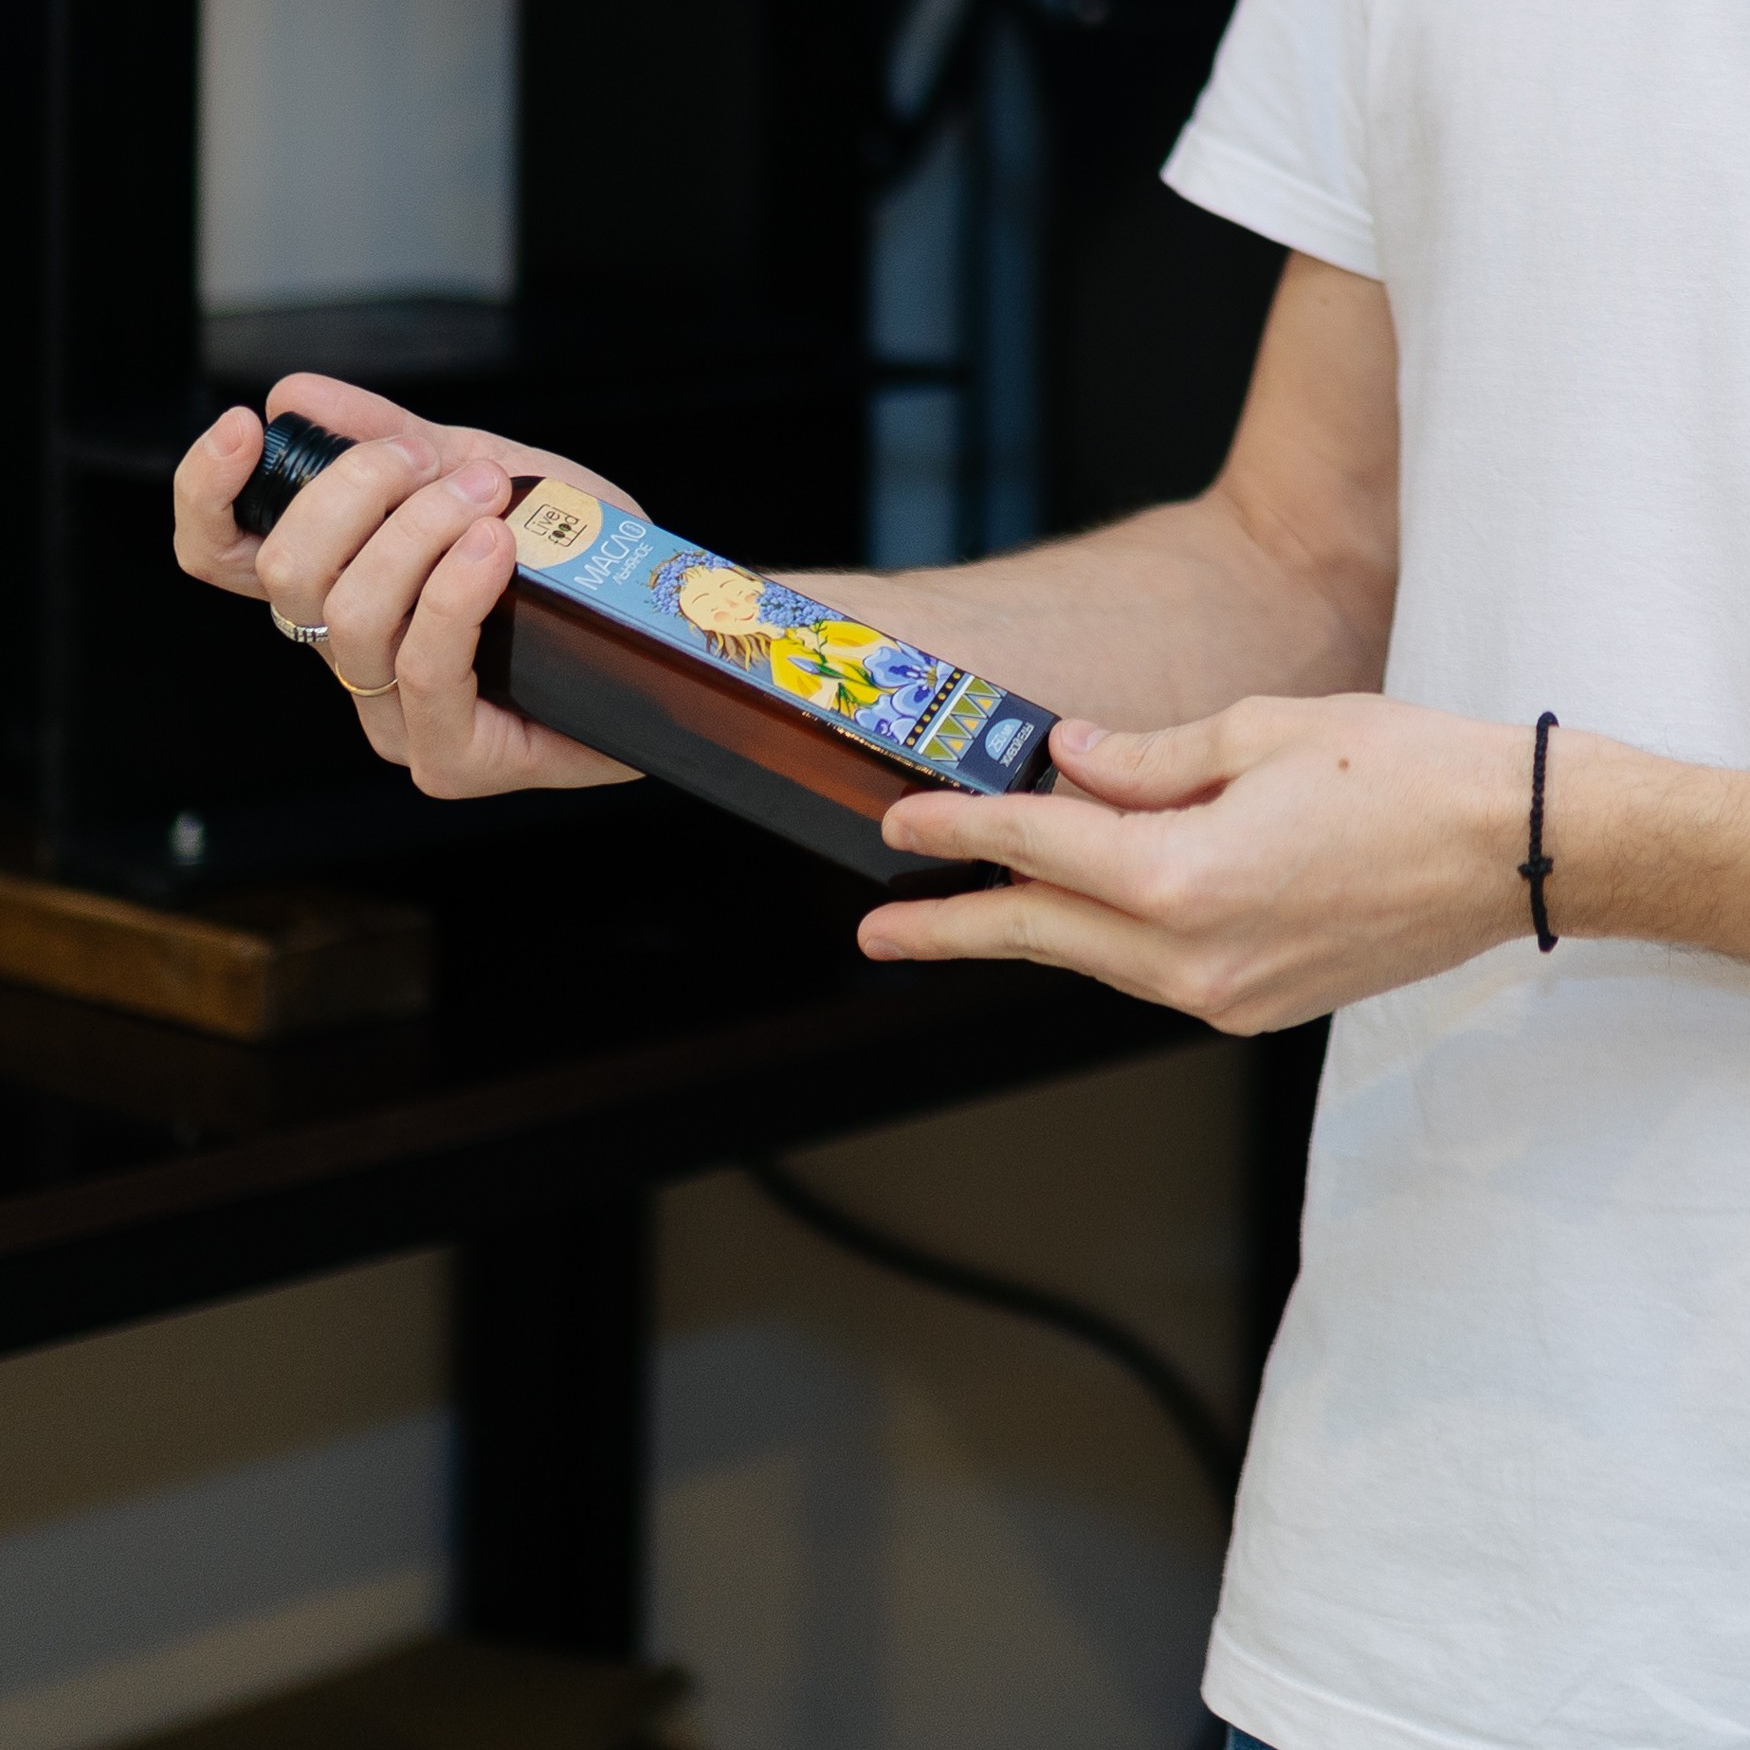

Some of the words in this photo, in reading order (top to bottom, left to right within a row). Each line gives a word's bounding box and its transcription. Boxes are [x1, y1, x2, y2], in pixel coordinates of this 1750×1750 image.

[530, 509, 560, 536] Live
[574, 520, 646, 591] МАСЛО
[612, 542, 653, 585] ЛЬНЯНОЕ
